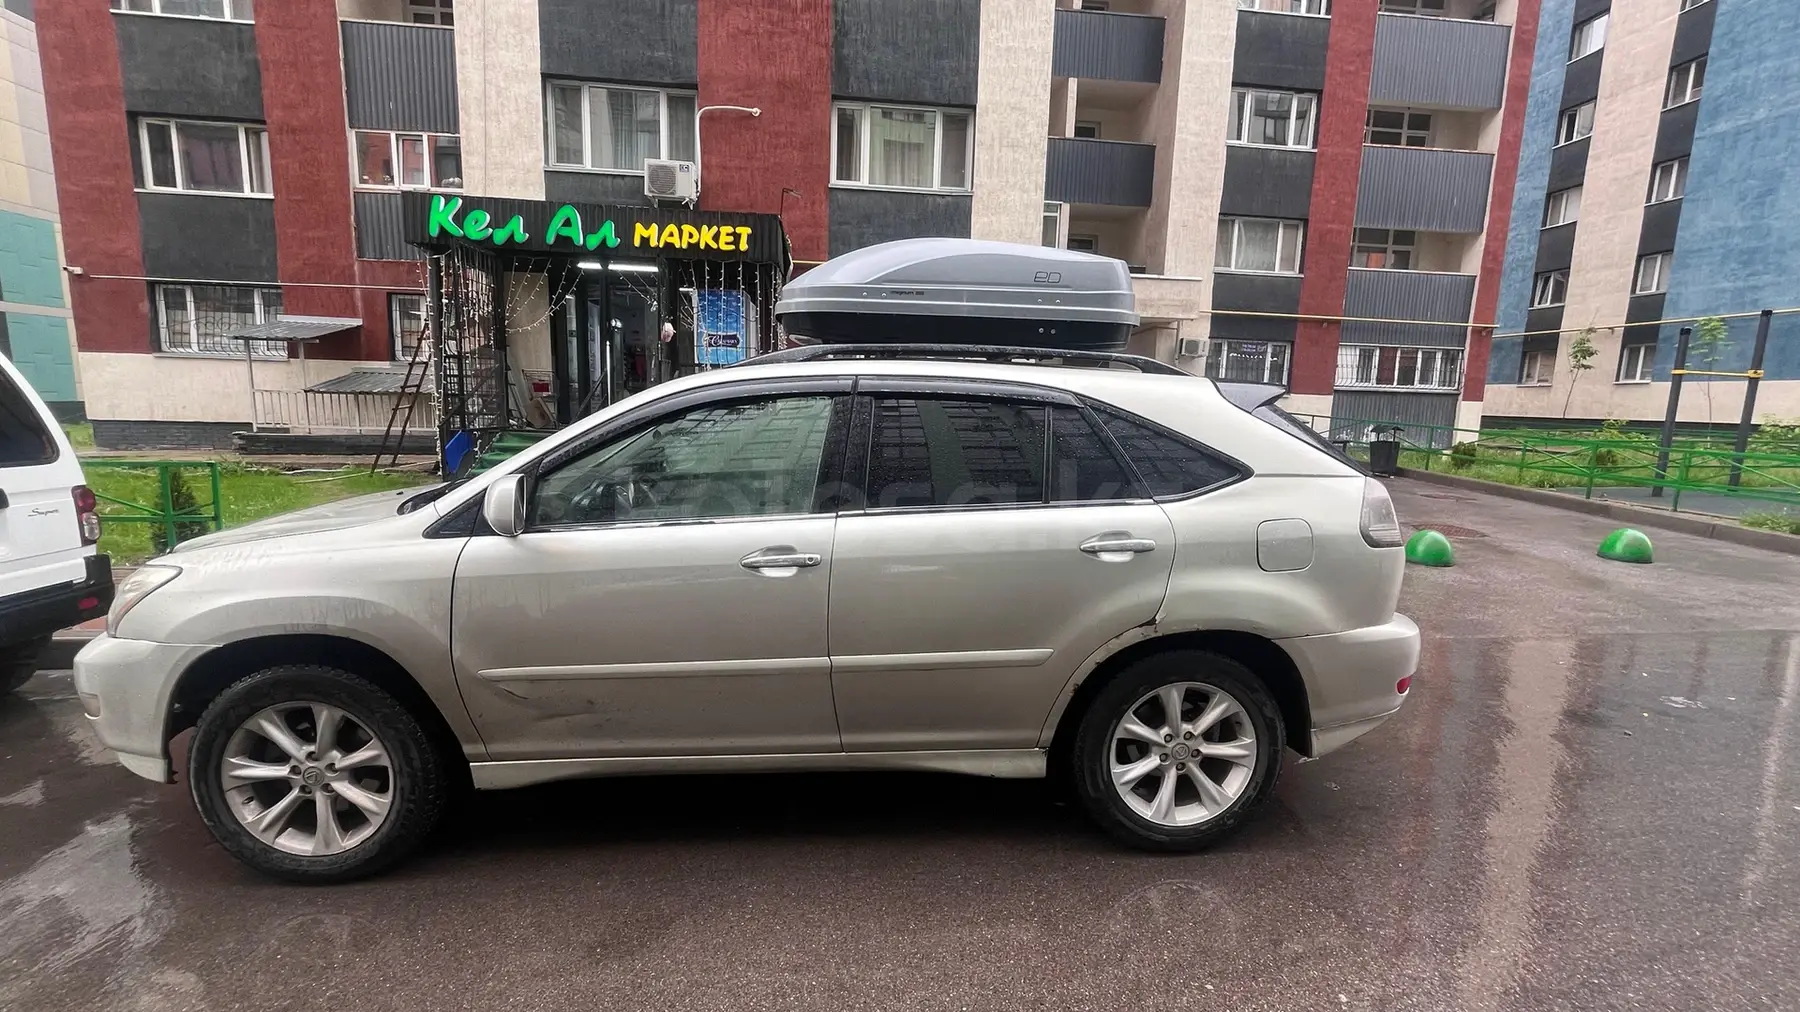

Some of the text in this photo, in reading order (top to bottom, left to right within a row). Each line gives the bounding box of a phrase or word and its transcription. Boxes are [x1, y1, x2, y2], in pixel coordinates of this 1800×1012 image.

[428, 195, 753, 252] Кел Ал МАРКЕТ
